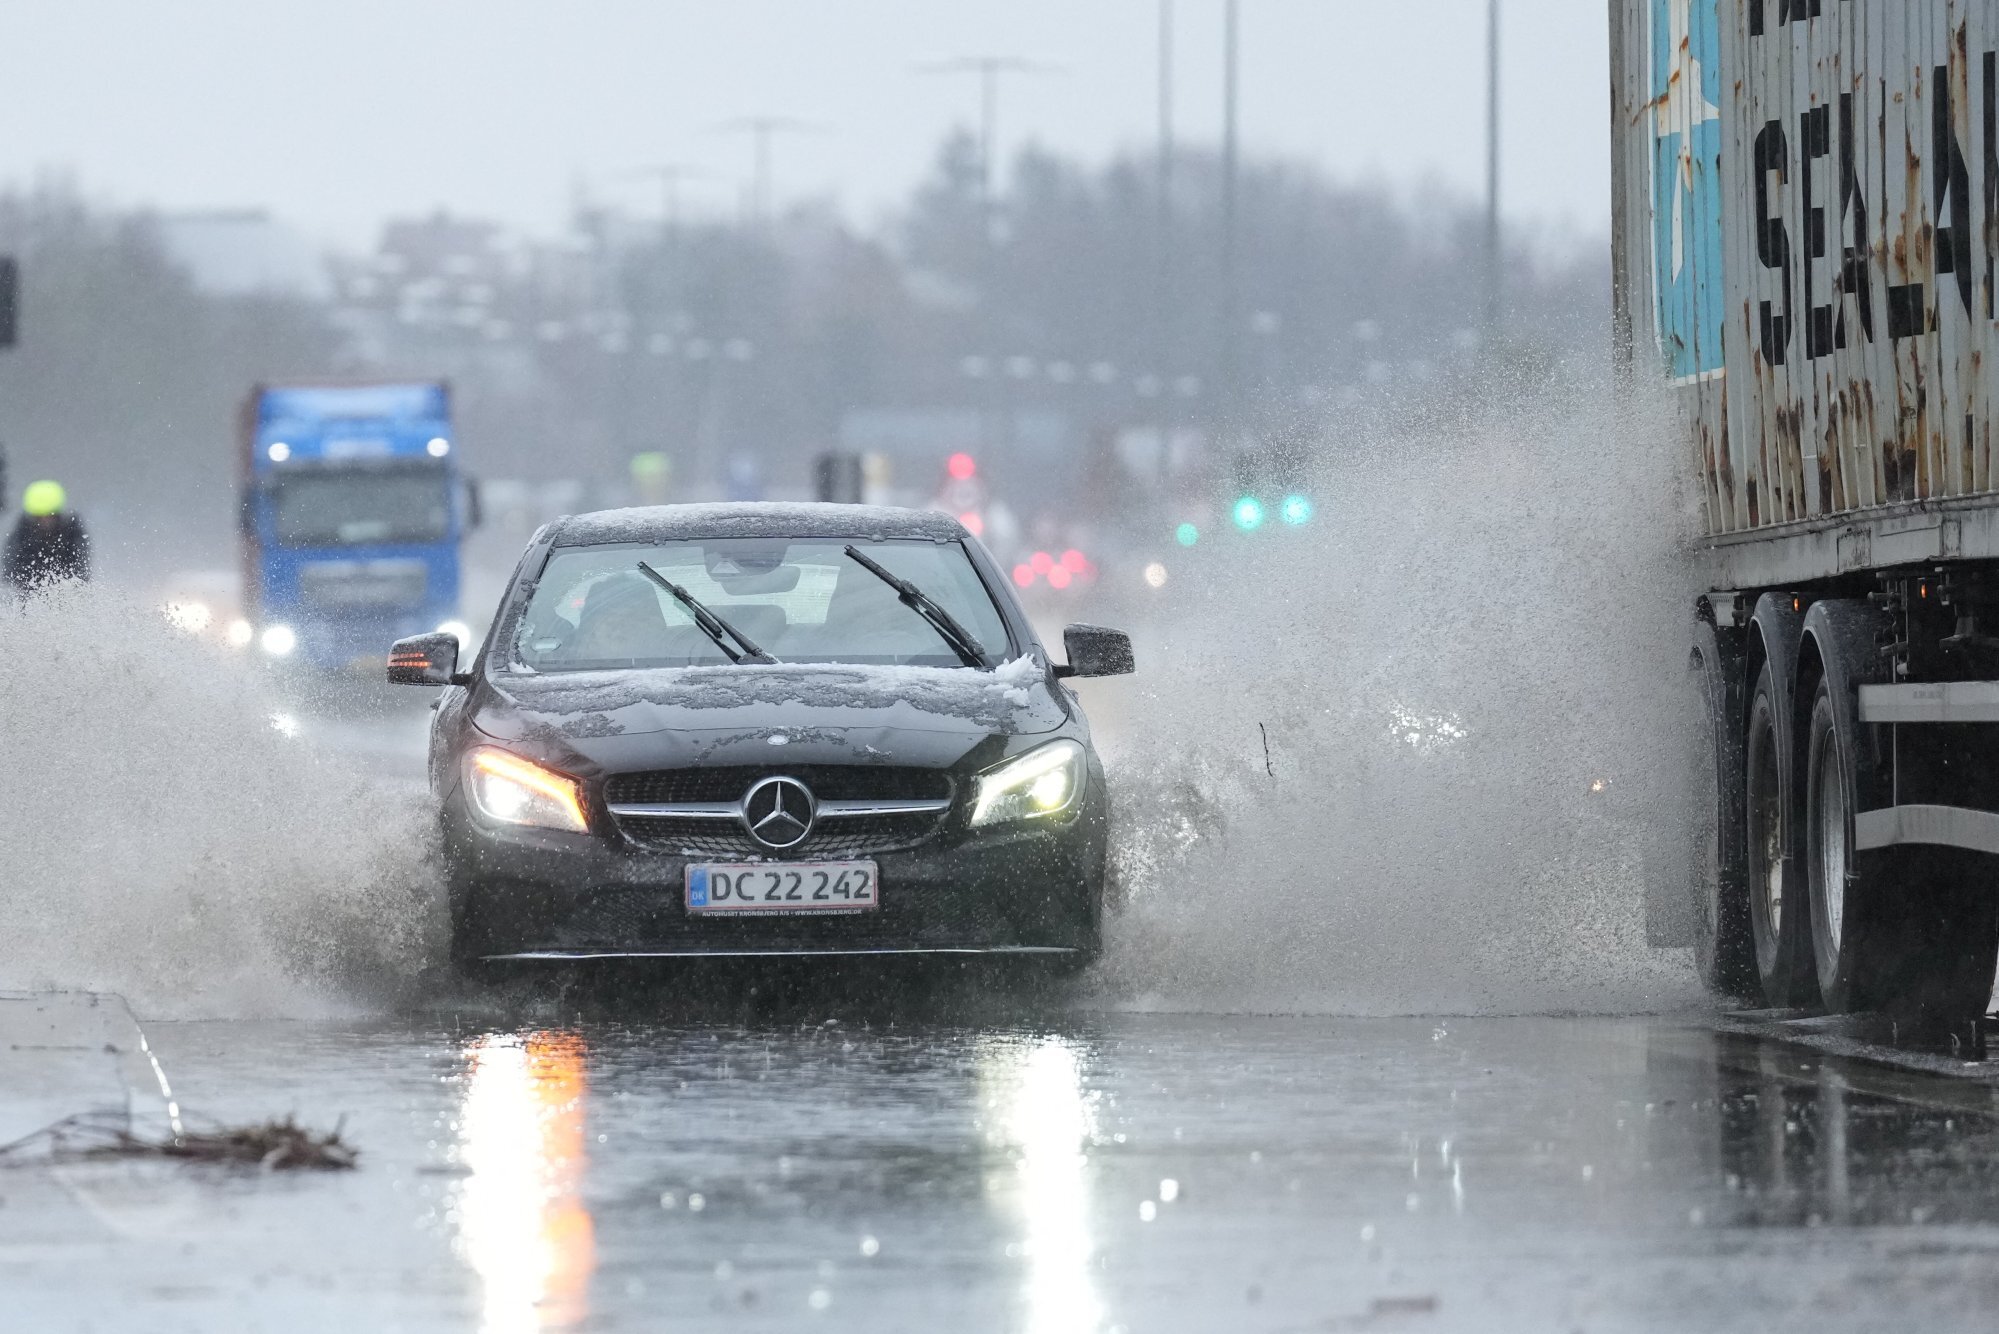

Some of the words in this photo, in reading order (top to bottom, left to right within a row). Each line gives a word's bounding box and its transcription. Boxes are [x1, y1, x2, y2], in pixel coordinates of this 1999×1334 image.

[711, 872, 755, 901] DC
[764, 872, 802, 901] 22
[812, 869, 870, 901] 242
[692, 891, 705, 901] DK
